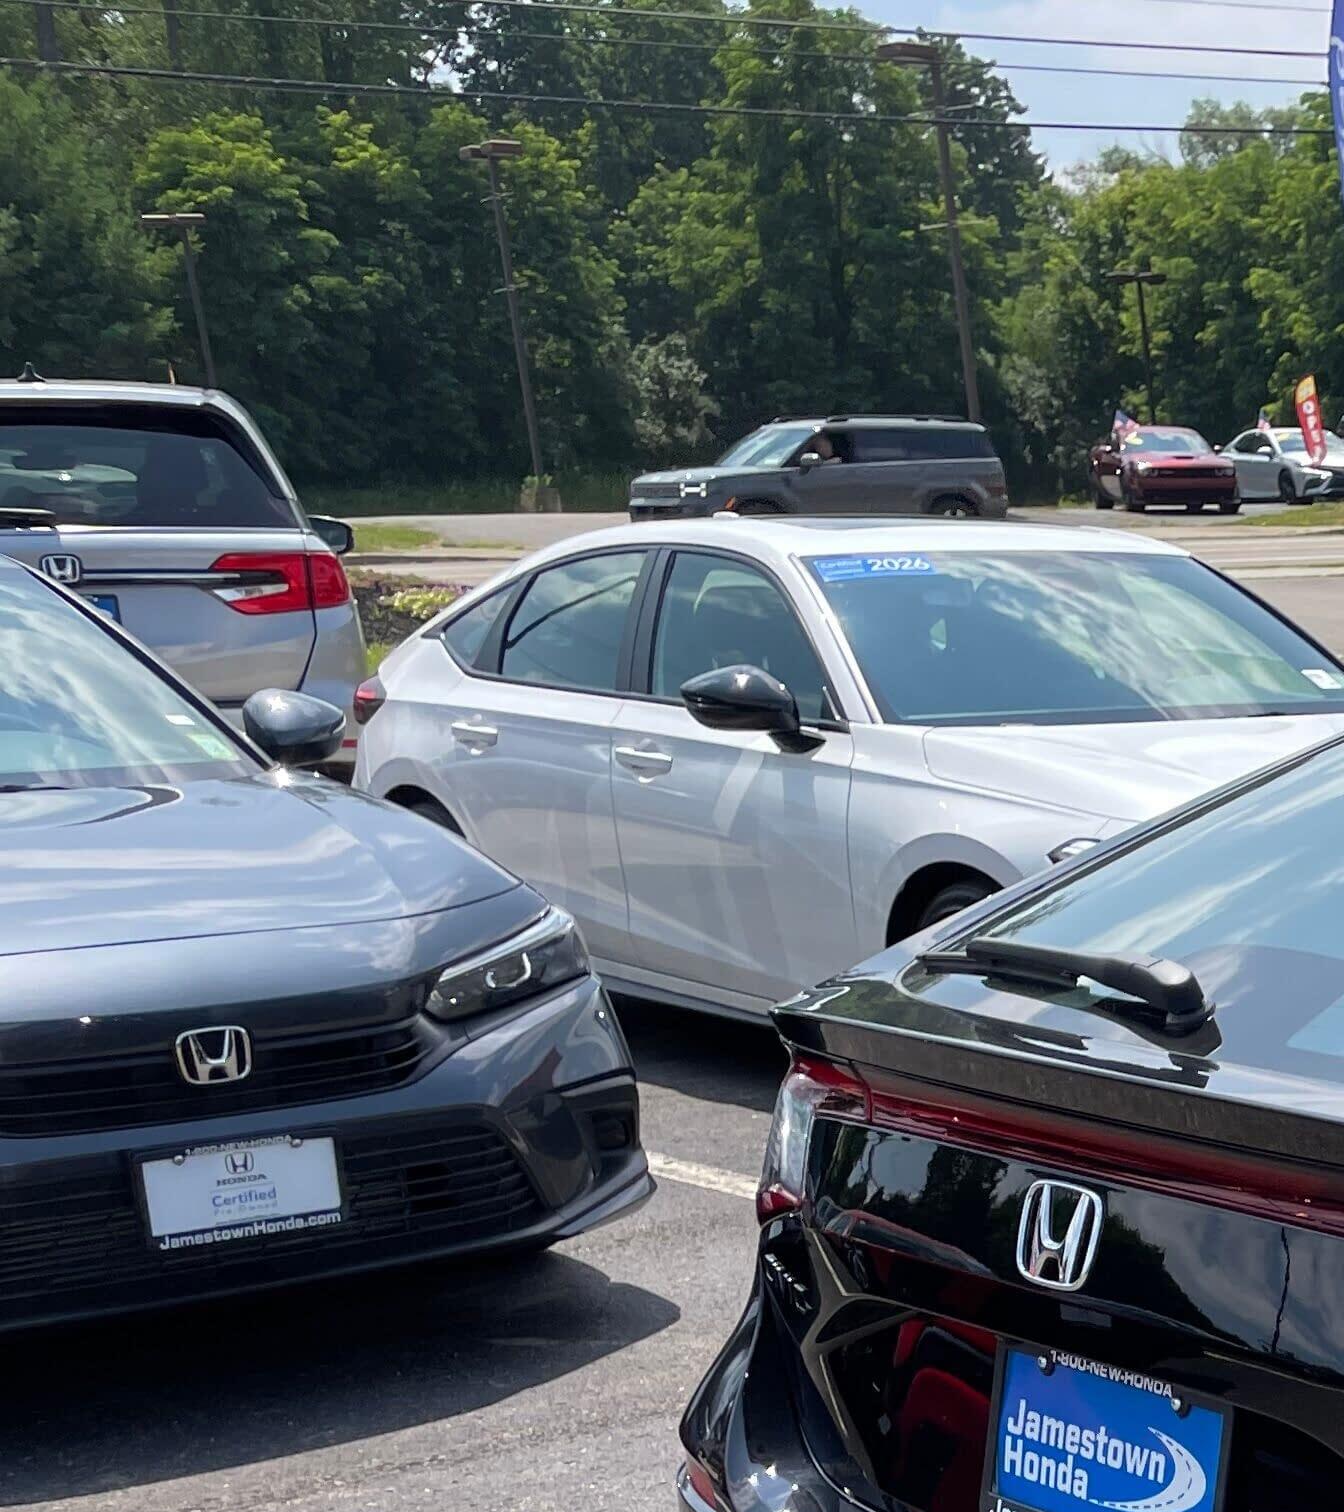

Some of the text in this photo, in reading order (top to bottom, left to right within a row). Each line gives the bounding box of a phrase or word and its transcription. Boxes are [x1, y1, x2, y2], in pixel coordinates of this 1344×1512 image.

[867, 556, 930, 571] 2026
[216, 1173, 267, 1187] HONDA
[212, 1186, 278, 1208] Certified
[160, 1211, 342, 1251] JamestownHonda.com
[1007, 1398, 1166, 1485] Jamestown
[1004, 1434, 1089, 1501] Honda
